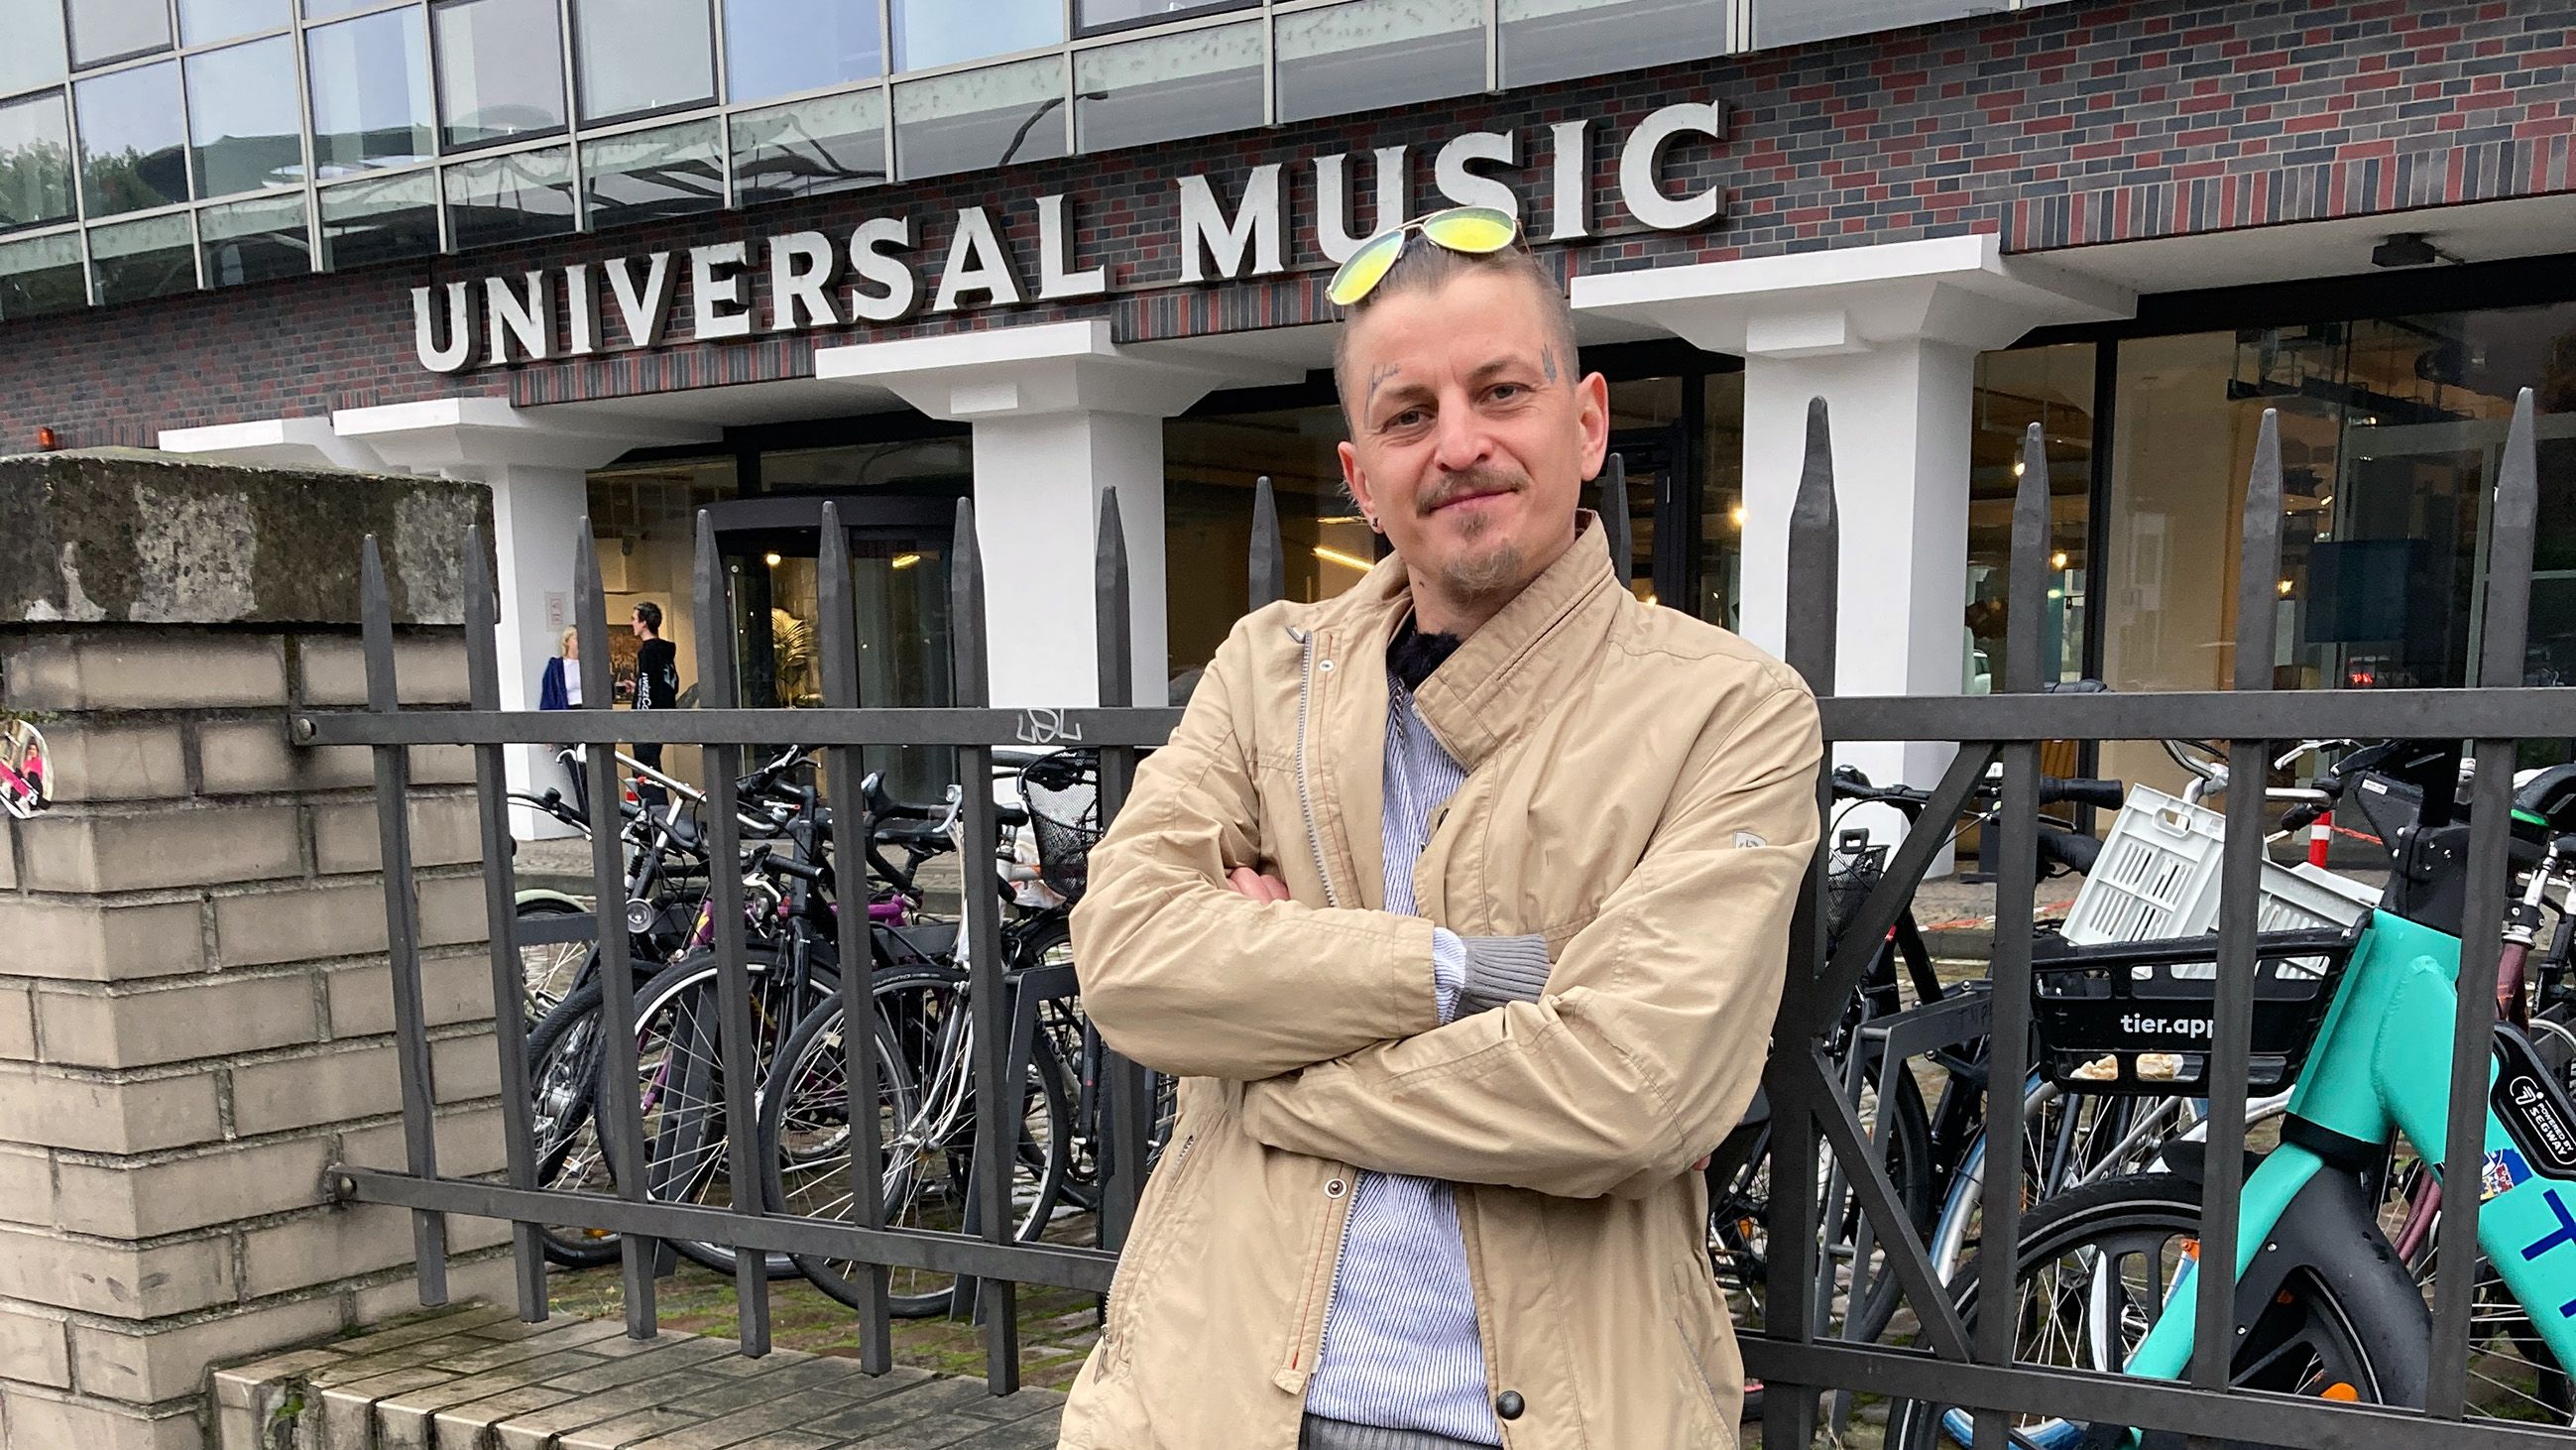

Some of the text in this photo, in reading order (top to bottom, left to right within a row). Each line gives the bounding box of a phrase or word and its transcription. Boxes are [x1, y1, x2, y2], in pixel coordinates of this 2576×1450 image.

[411, 99, 1725, 373] UNIVERSAL MUSIC
[2528, 1106, 2568, 1155] SEGWAY
[2537, 1102, 2574, 1151] POWERED BY
